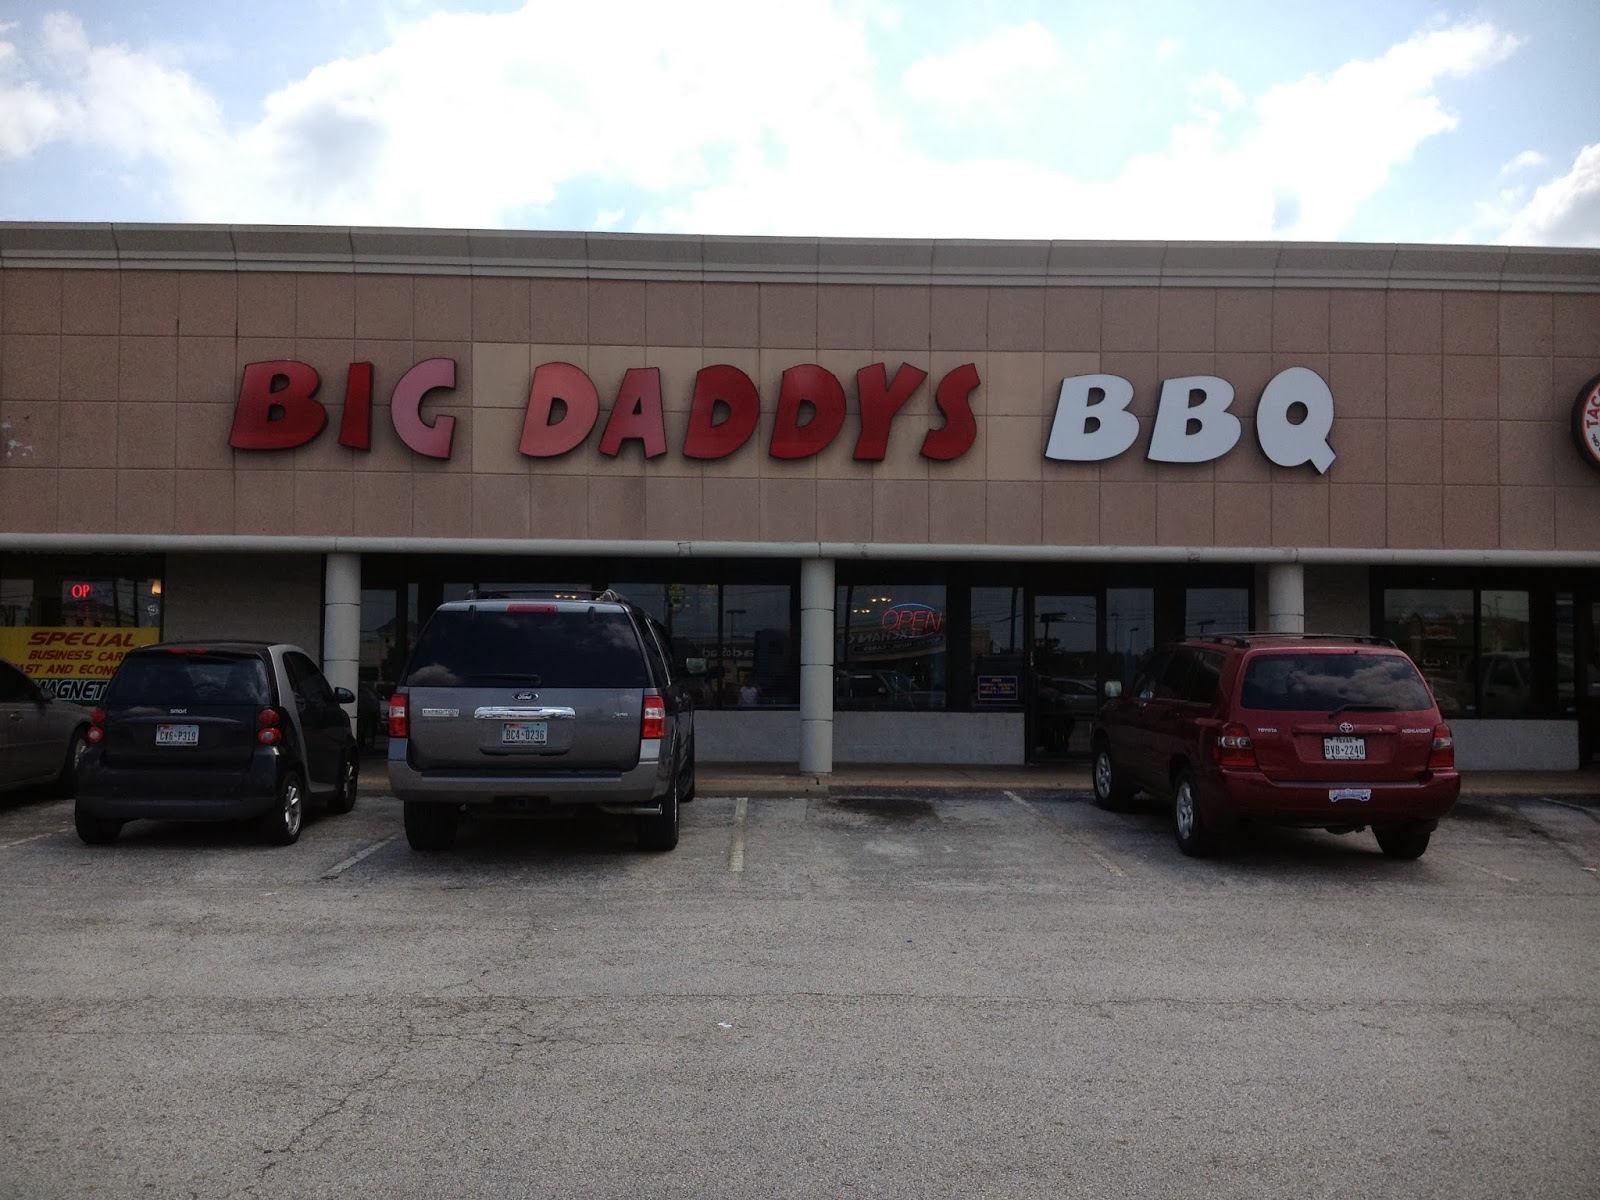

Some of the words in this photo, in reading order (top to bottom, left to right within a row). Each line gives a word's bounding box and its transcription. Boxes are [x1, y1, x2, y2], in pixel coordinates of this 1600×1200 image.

[228, 358, 457, 460] BIG
[518, 361, 981, 461] DADDYS
[1044, 365, 1337, 475] BBQ
[882, 609, 943, 632] OPEN
[27, 631, 136, 647] SPECIAL
[28, 650, 94, 661] BUSINESS
[15, 663, 43, 674] AST
[45, 664, 74, 674] AND
